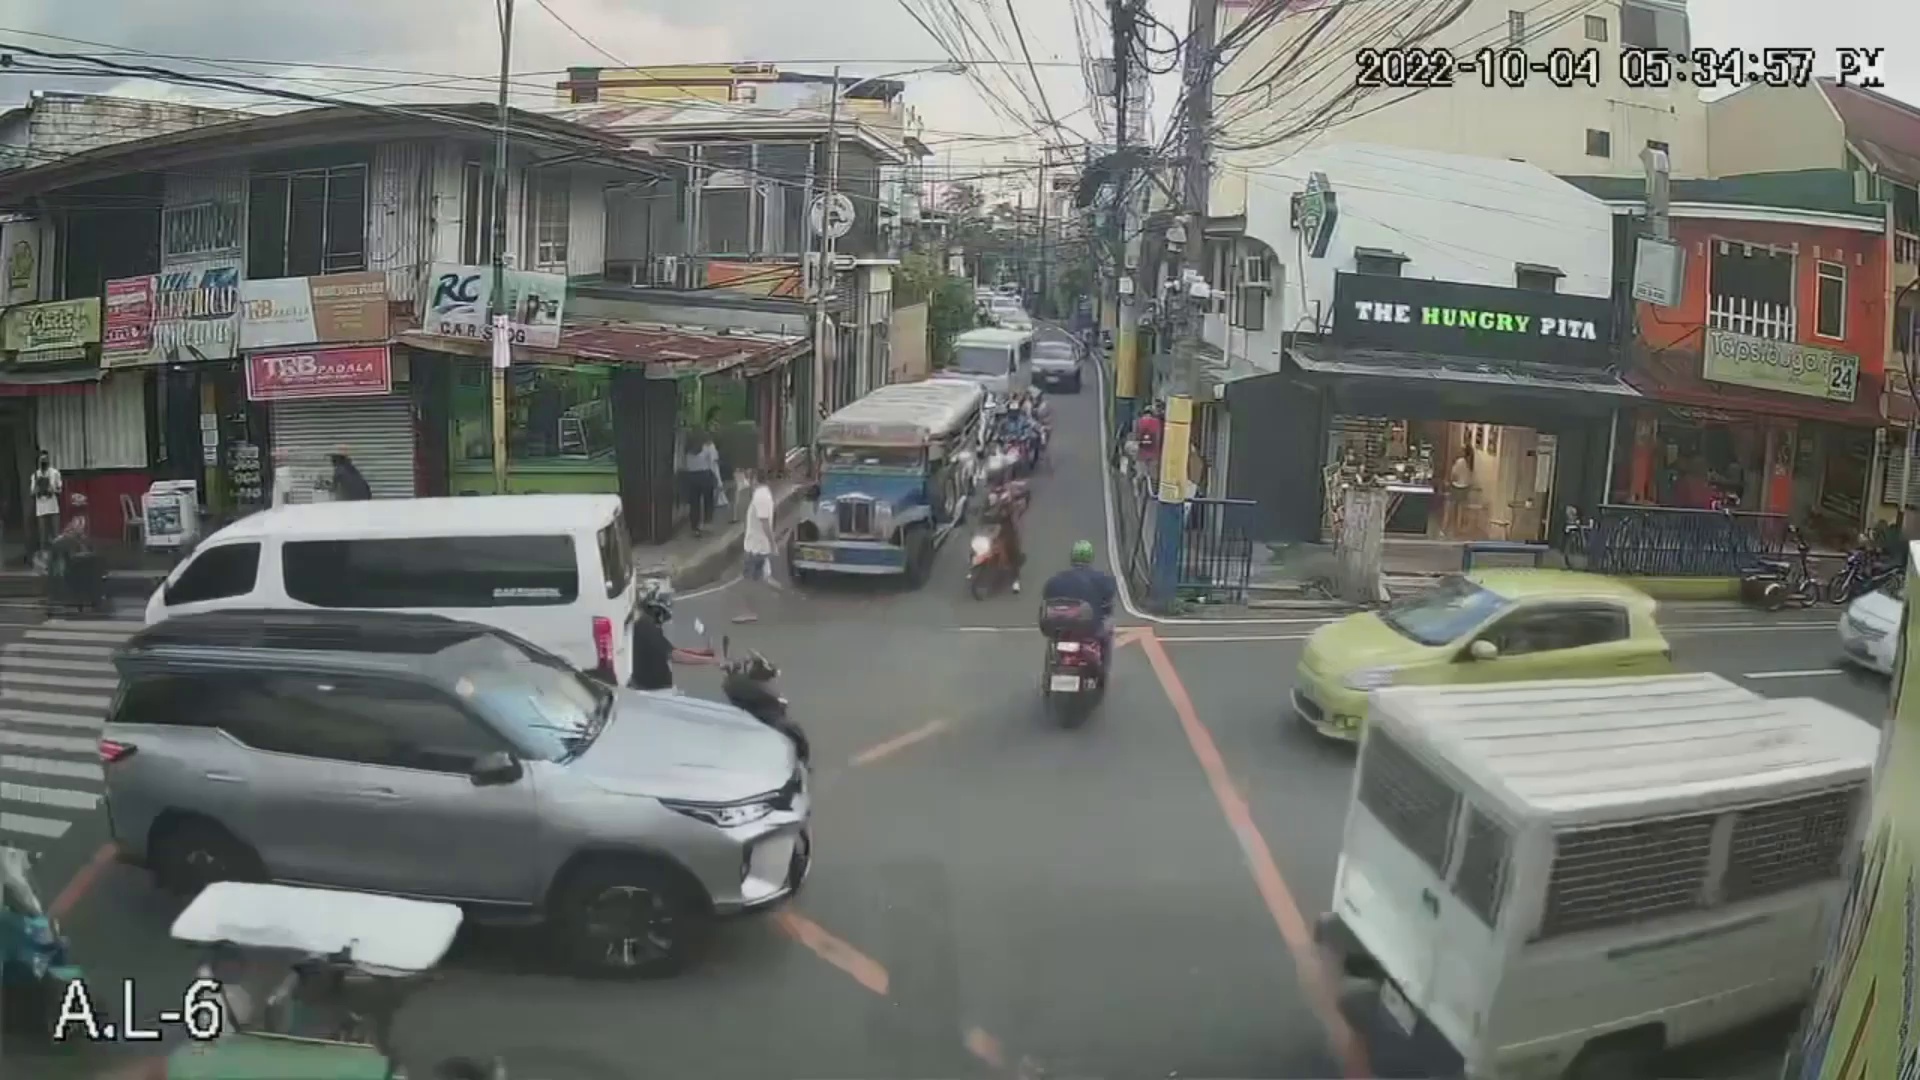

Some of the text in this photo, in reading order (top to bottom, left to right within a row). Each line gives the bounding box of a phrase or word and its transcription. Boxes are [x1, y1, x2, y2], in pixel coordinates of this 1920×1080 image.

[432, 273, 480, 309] RC
[1355, 301, 1597, 341] THE HUNGRY PITA
[263, 355, 373, 377] TRB PADALA
[1831, 366, 1852, 390] 24
